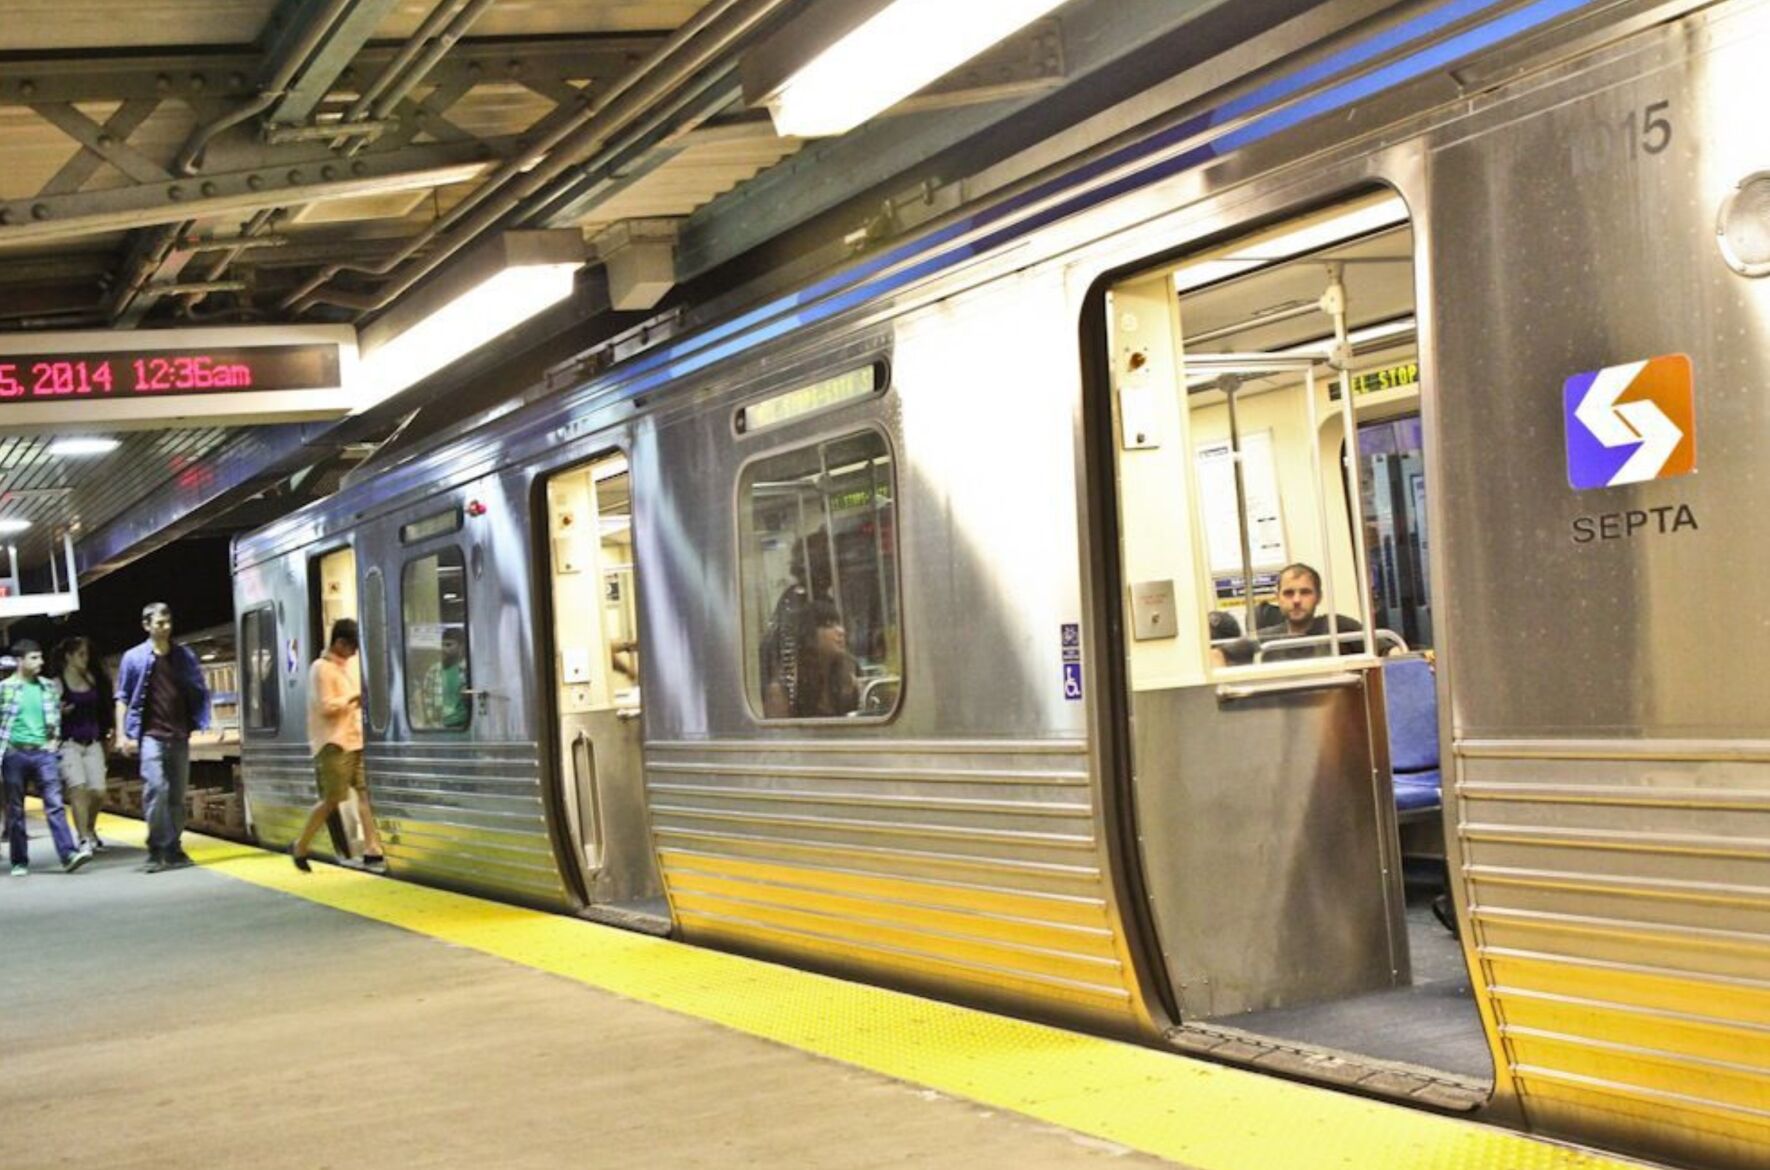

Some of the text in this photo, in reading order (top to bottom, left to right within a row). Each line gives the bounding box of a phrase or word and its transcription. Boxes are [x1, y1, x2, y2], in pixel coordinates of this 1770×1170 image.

[33, 361, 112, 395] 2014
[133, 356, 251, 391] 12:36am
[1379, 363, 1417, 391] STOP
[1572, 504, 1698, 543] SEPTA
